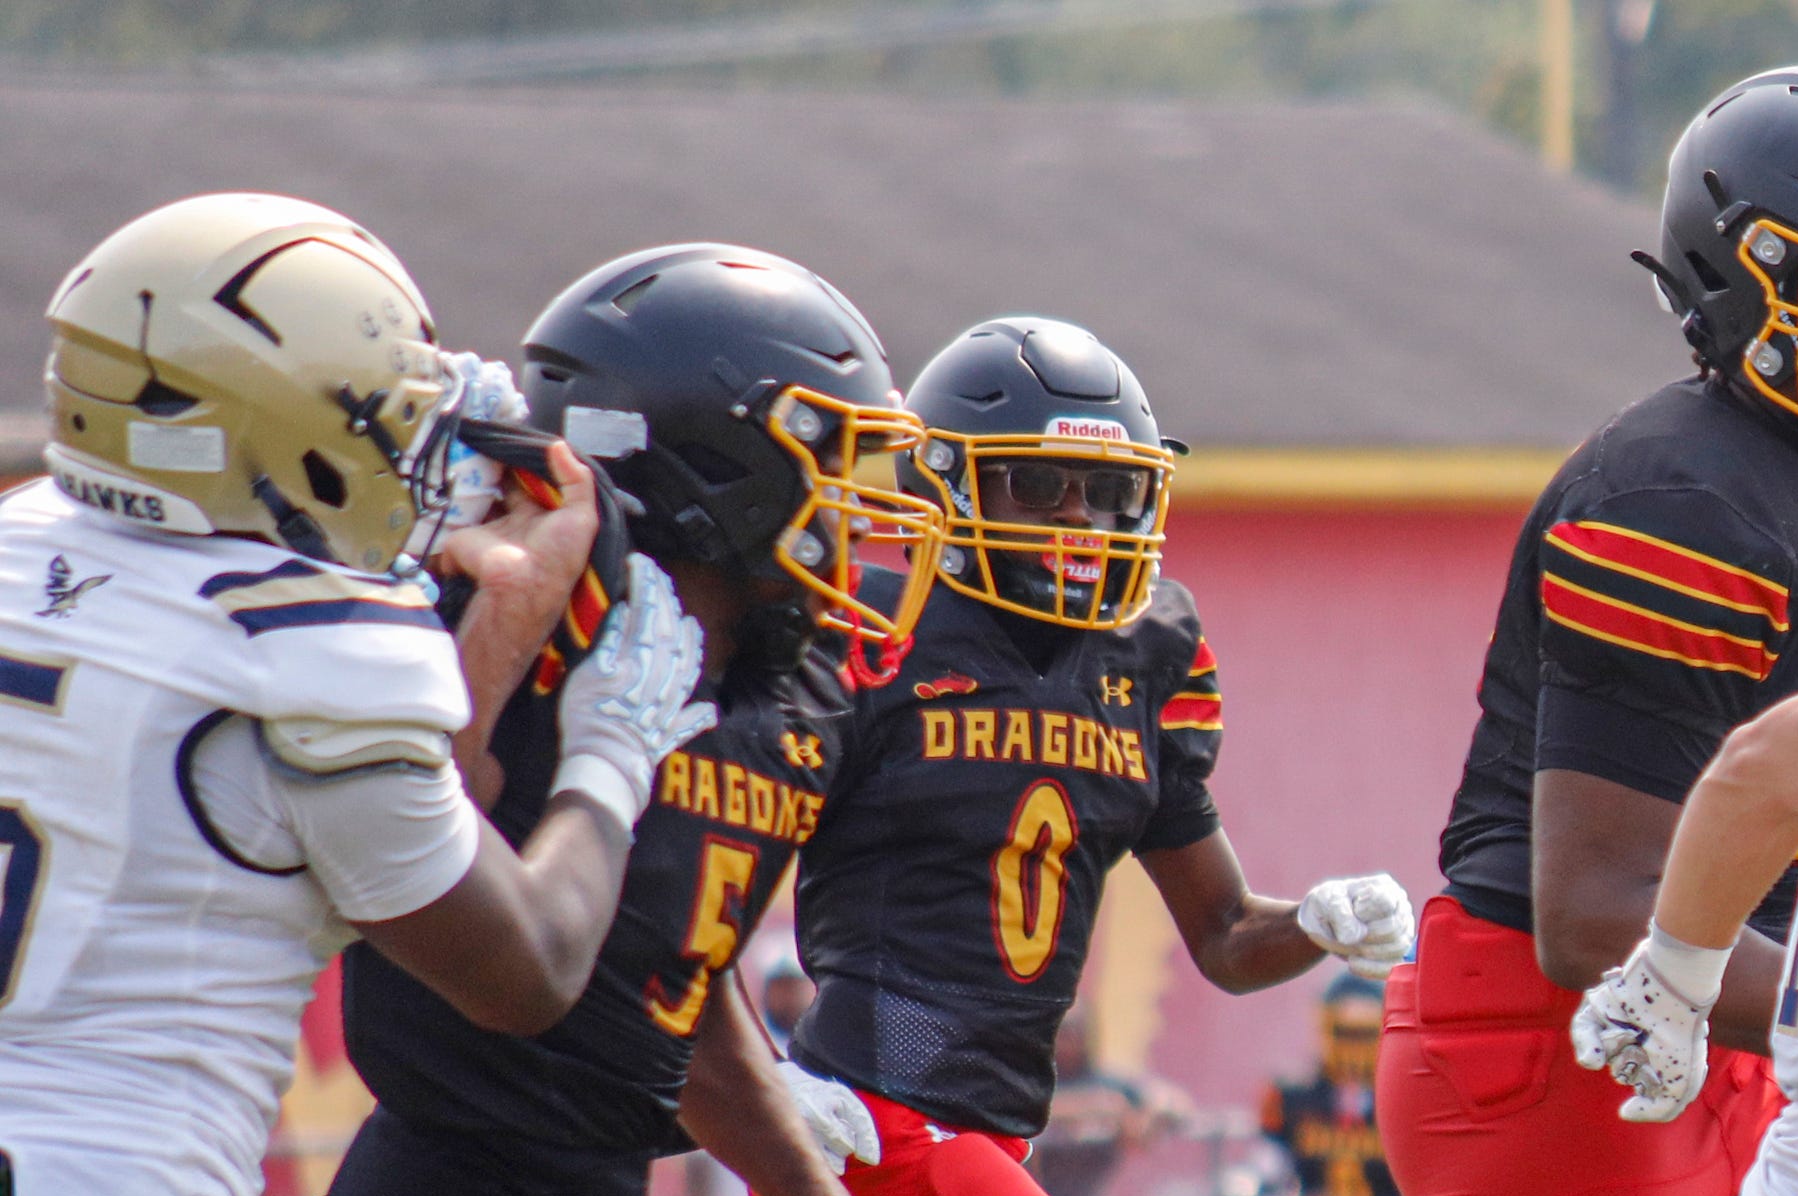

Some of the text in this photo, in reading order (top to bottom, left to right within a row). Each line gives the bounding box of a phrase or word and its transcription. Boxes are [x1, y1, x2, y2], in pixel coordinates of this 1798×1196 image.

[1057, 421, 1122, 440] Riddell
[919, 709, 1149, 783] DRAGONS
[658, 750, 827, 845] RAGONS
[989, 777, 1079, 984] 0
[644, 833, 763, 1037] 5
